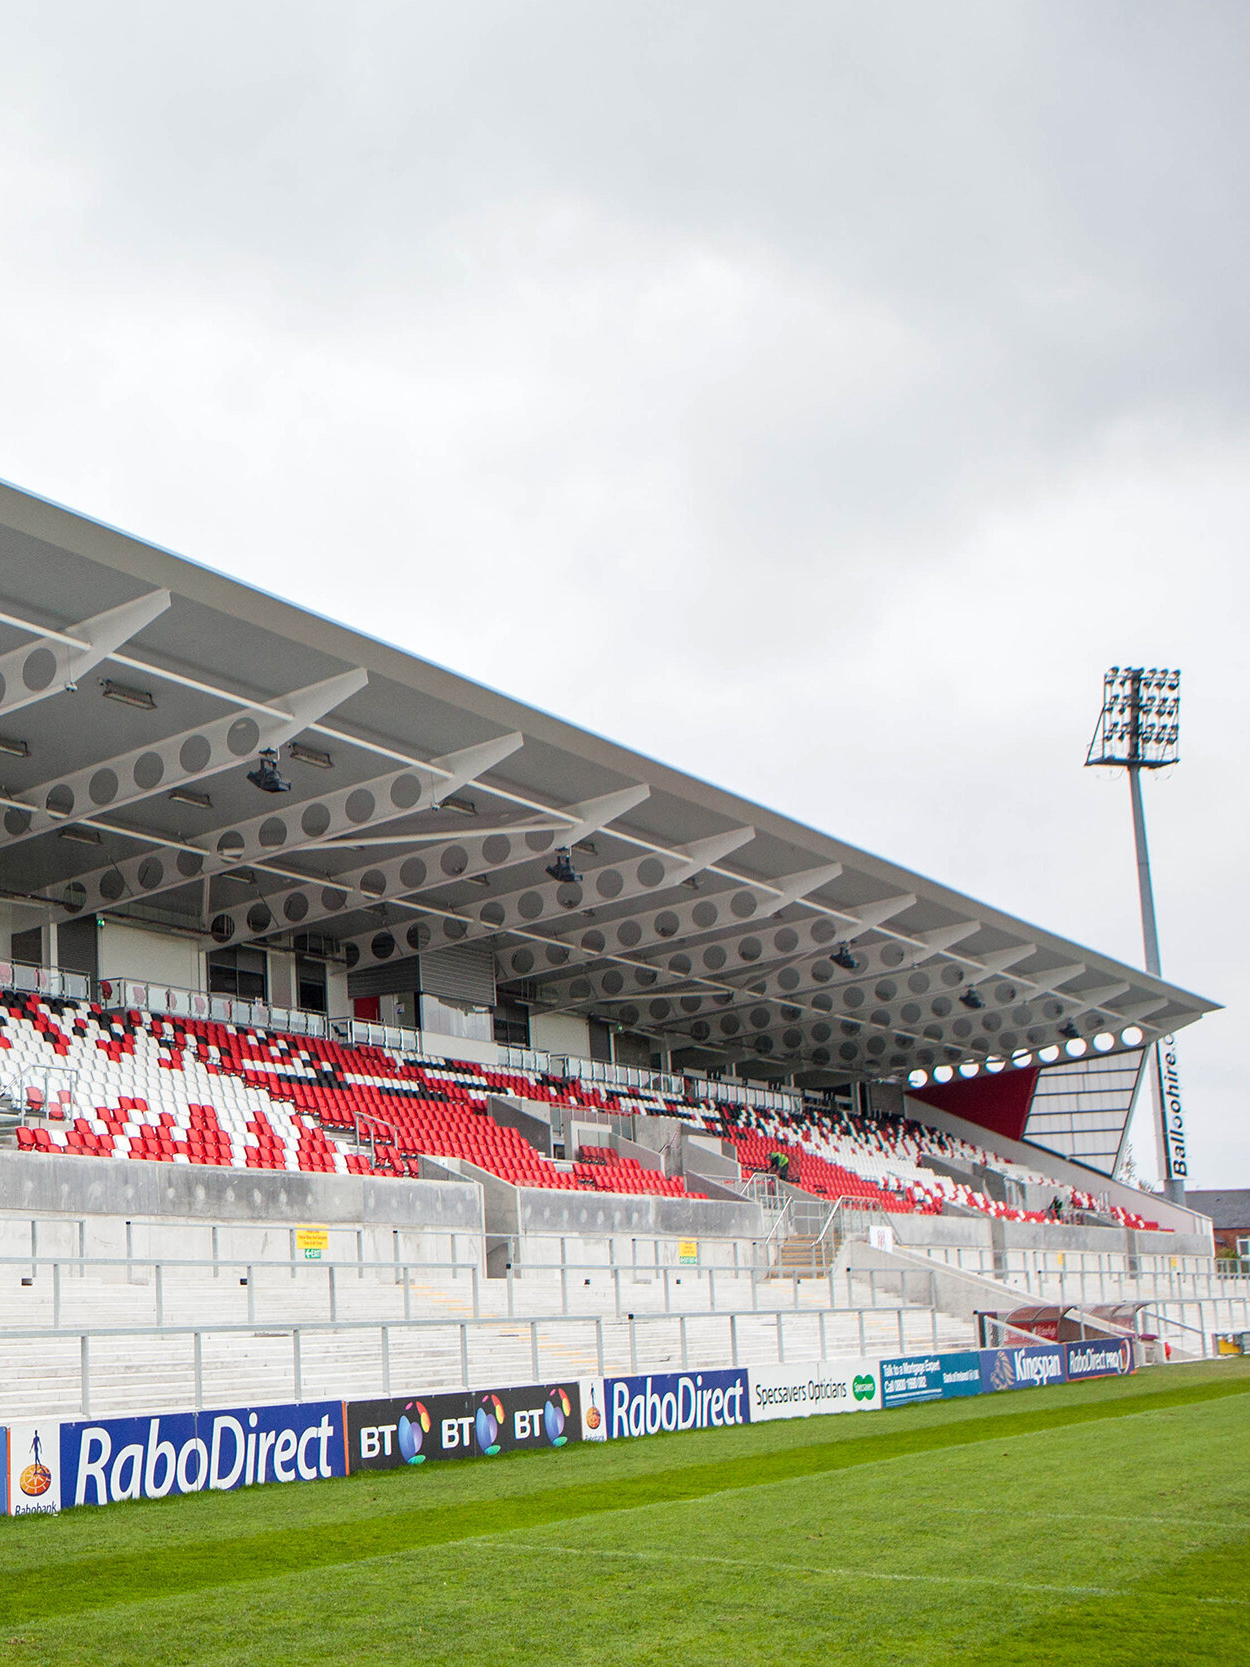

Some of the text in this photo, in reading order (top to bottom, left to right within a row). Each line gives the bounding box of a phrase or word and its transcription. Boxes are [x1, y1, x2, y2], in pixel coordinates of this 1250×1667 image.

[1014, 1348, 1062, 1386] Kingspan
[1069, 1347, 1106, 1374] RaboDirect
[612, 1375, 744, 1439] RaboDirect
[755, 1378, 847, 1410] Specsavers Opticians
[441, 1416, 475, 1450] BT
[514, 1408, 544, 1440] BT
[361, 1424, 397, 1459] BT
[74, 1412, 335, 1506] RaboDirect
